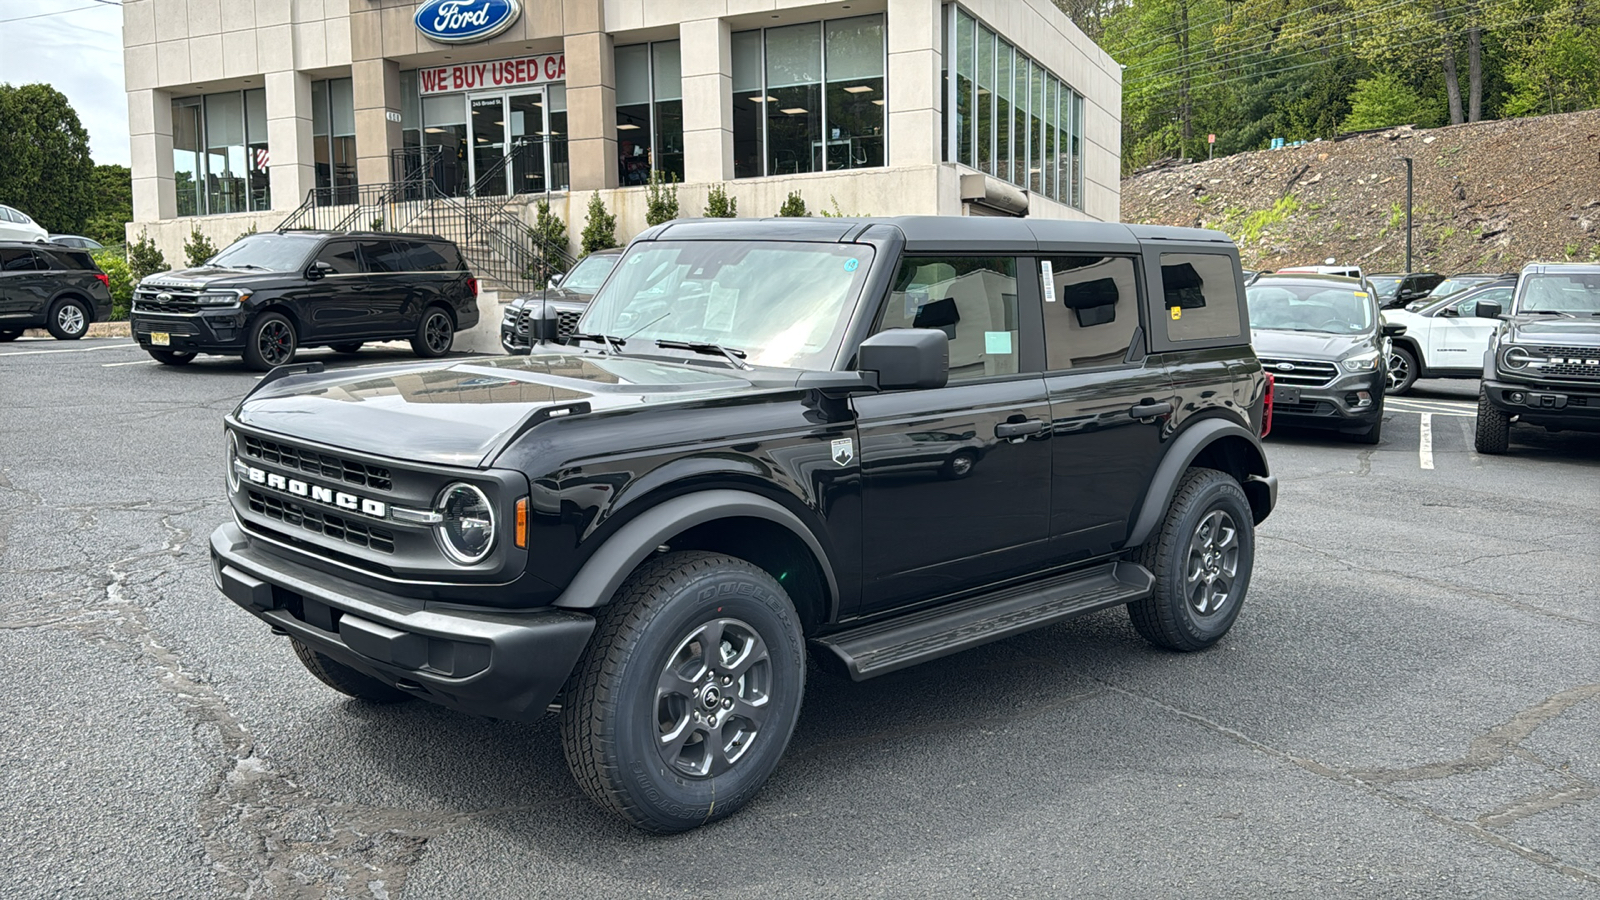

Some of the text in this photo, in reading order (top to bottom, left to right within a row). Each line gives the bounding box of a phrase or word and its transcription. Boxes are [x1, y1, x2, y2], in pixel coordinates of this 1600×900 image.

[434, 0, 490, 31] Ford
[421, 69, 448, 92] WE
[453, 64, 487, 89] BUY
[492, 59, 538, 85] USED
[249, 467, 385, 517] BRONCO
[697, 581, 793, 630] DUELER
